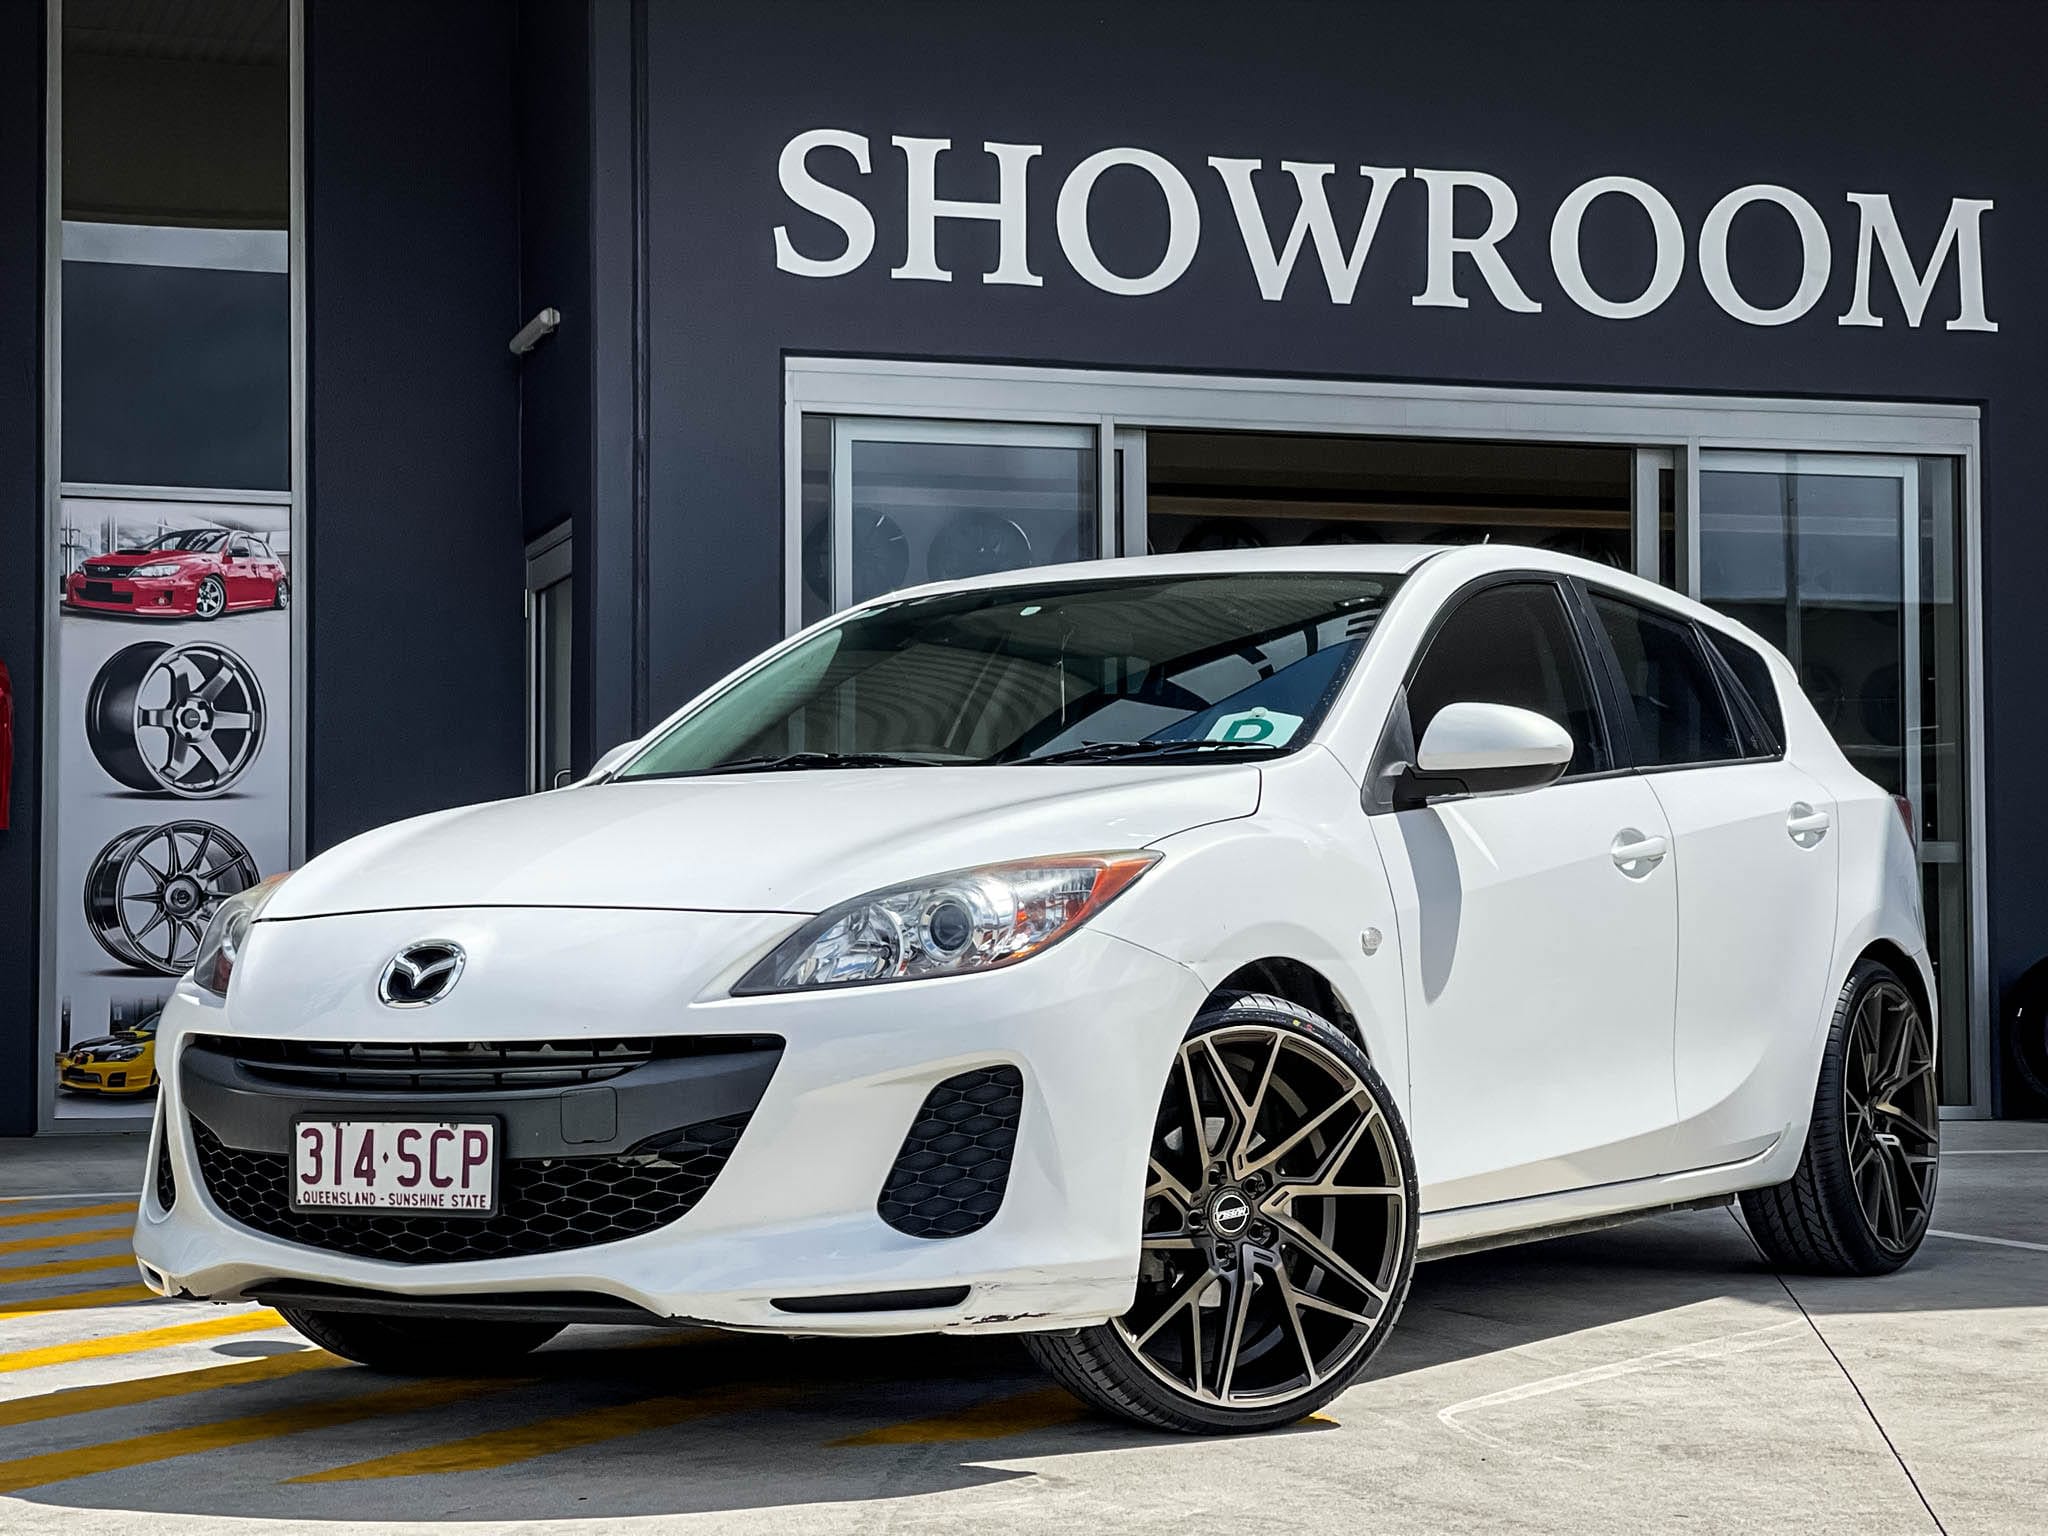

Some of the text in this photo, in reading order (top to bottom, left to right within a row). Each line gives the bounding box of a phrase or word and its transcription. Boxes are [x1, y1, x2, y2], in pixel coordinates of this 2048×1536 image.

[774, 129, 1999, 332] SHOWROOM
[303, 1191, 376, 1206] QUEENSLAND
[388, 1193, 445, 1207] SUNSHINE
[451, 1194, 487, 1208] STATE
